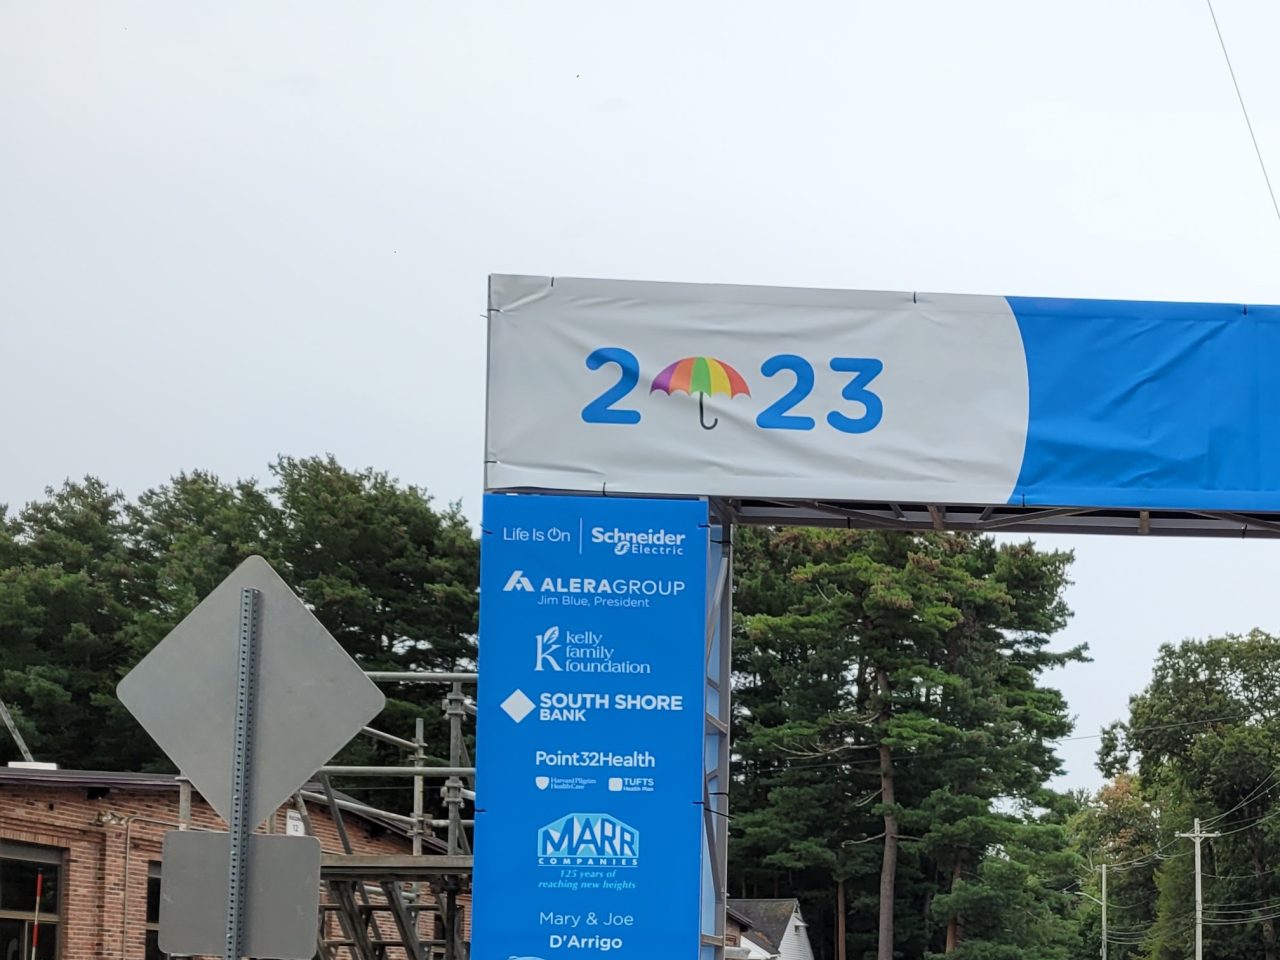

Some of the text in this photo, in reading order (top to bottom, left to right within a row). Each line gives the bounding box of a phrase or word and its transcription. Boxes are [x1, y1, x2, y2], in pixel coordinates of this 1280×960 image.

[503, 527, 571, 542] Life Is On
[592, 526, 686, 546] Schneider
[632, 544, 684, 556] Electric
[537, 595, 651, 608] Jim Blue, President
[565, 630, 603, 648] kelly
[565, 645, 615, 661] family
[565, 659, 651, 674] foundation
[539, 692, 683, 711] SOUTH SHORE
[539, 709, 586, 722] BANK
[535, 750, 656, 768] Point32Health
[623, 777, 654, 786] TUFTS
[541, 816, 638, 856] MARR
[538, 858, 638, 866] COMPANIES
[560, 869, 618, 880] 125 years of
[538, 880, 636, 891] reaching new heights
[539, 912, 634, 928] Mary & Joe
[550, 934, 623, 952] D'Arrigo
